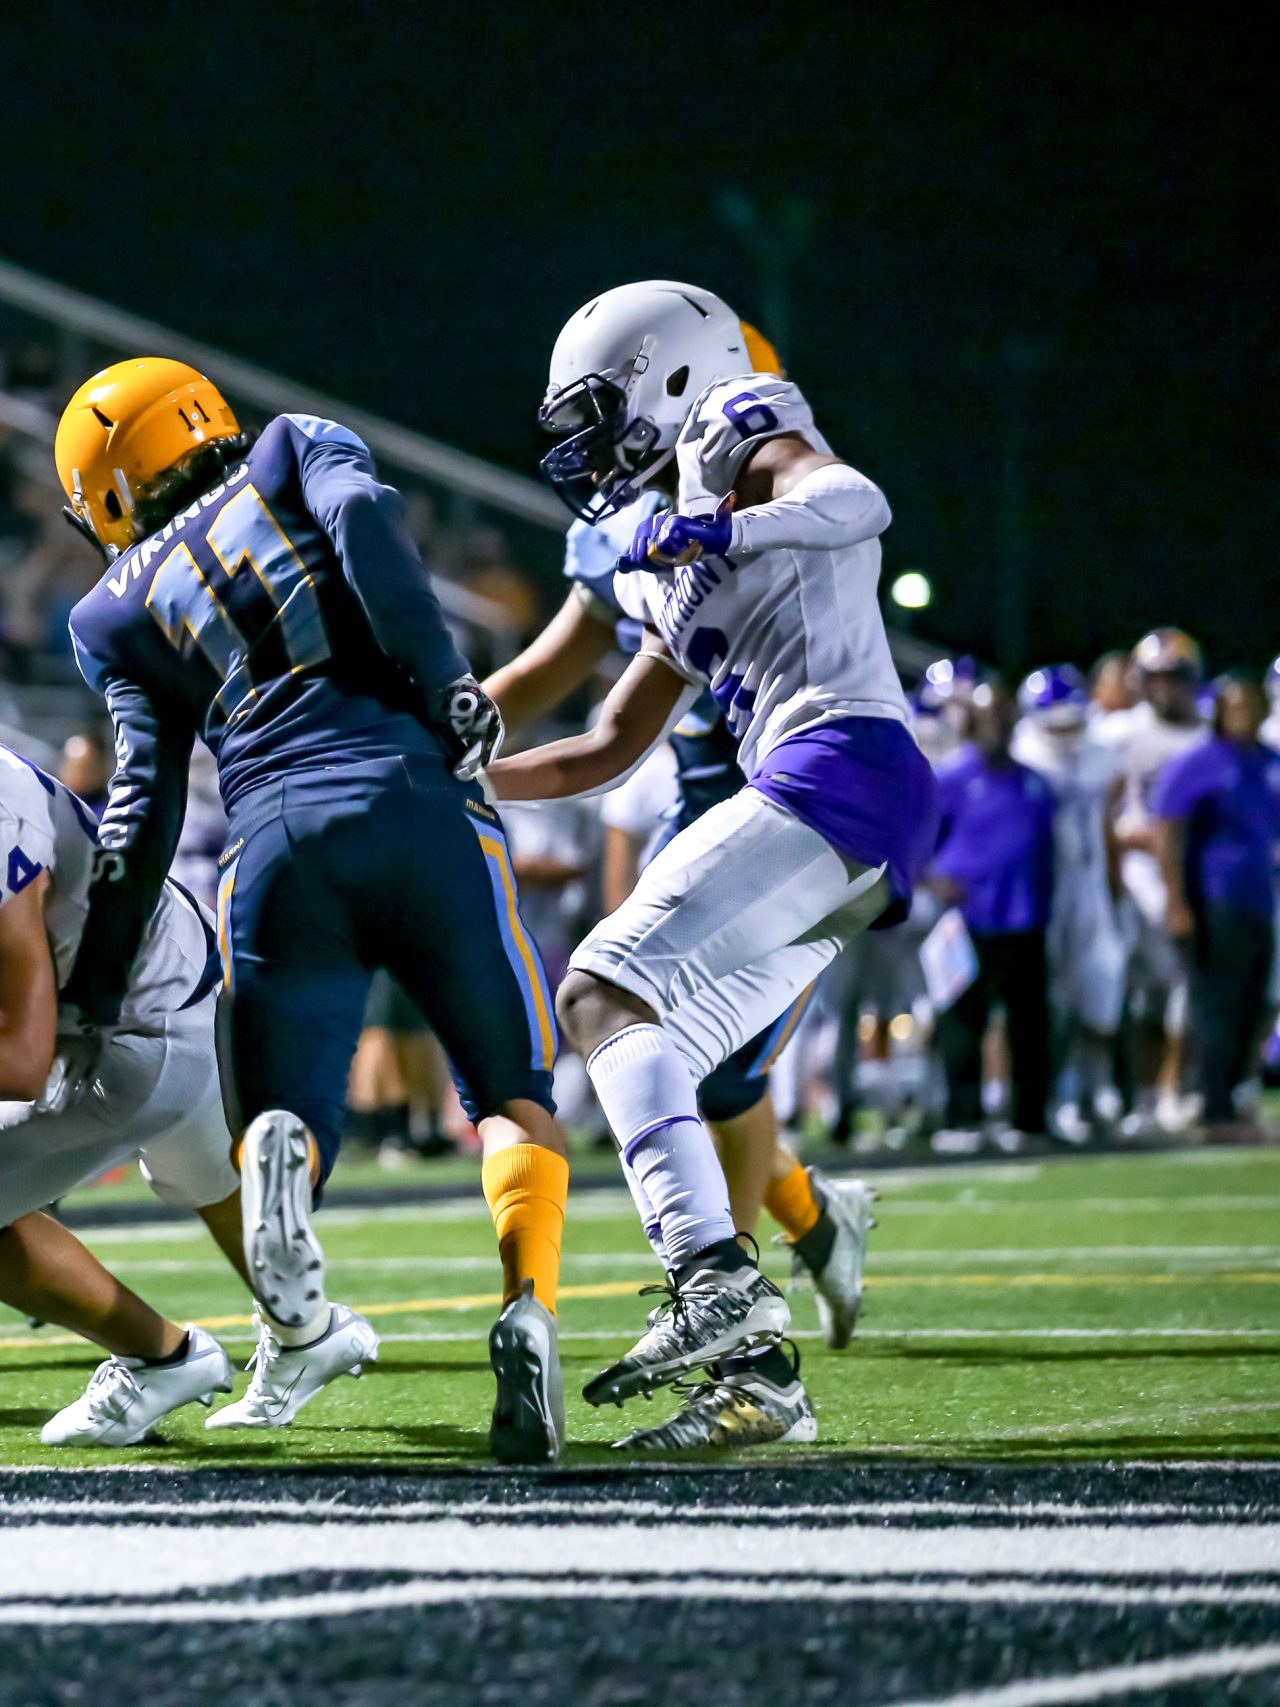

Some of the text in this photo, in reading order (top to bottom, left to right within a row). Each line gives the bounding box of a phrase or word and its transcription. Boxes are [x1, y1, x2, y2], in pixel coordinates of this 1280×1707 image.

[178, 399, 211, 432] 11
[722, 392, 779, 441] 6
[145, 482, 333, 727] 11
